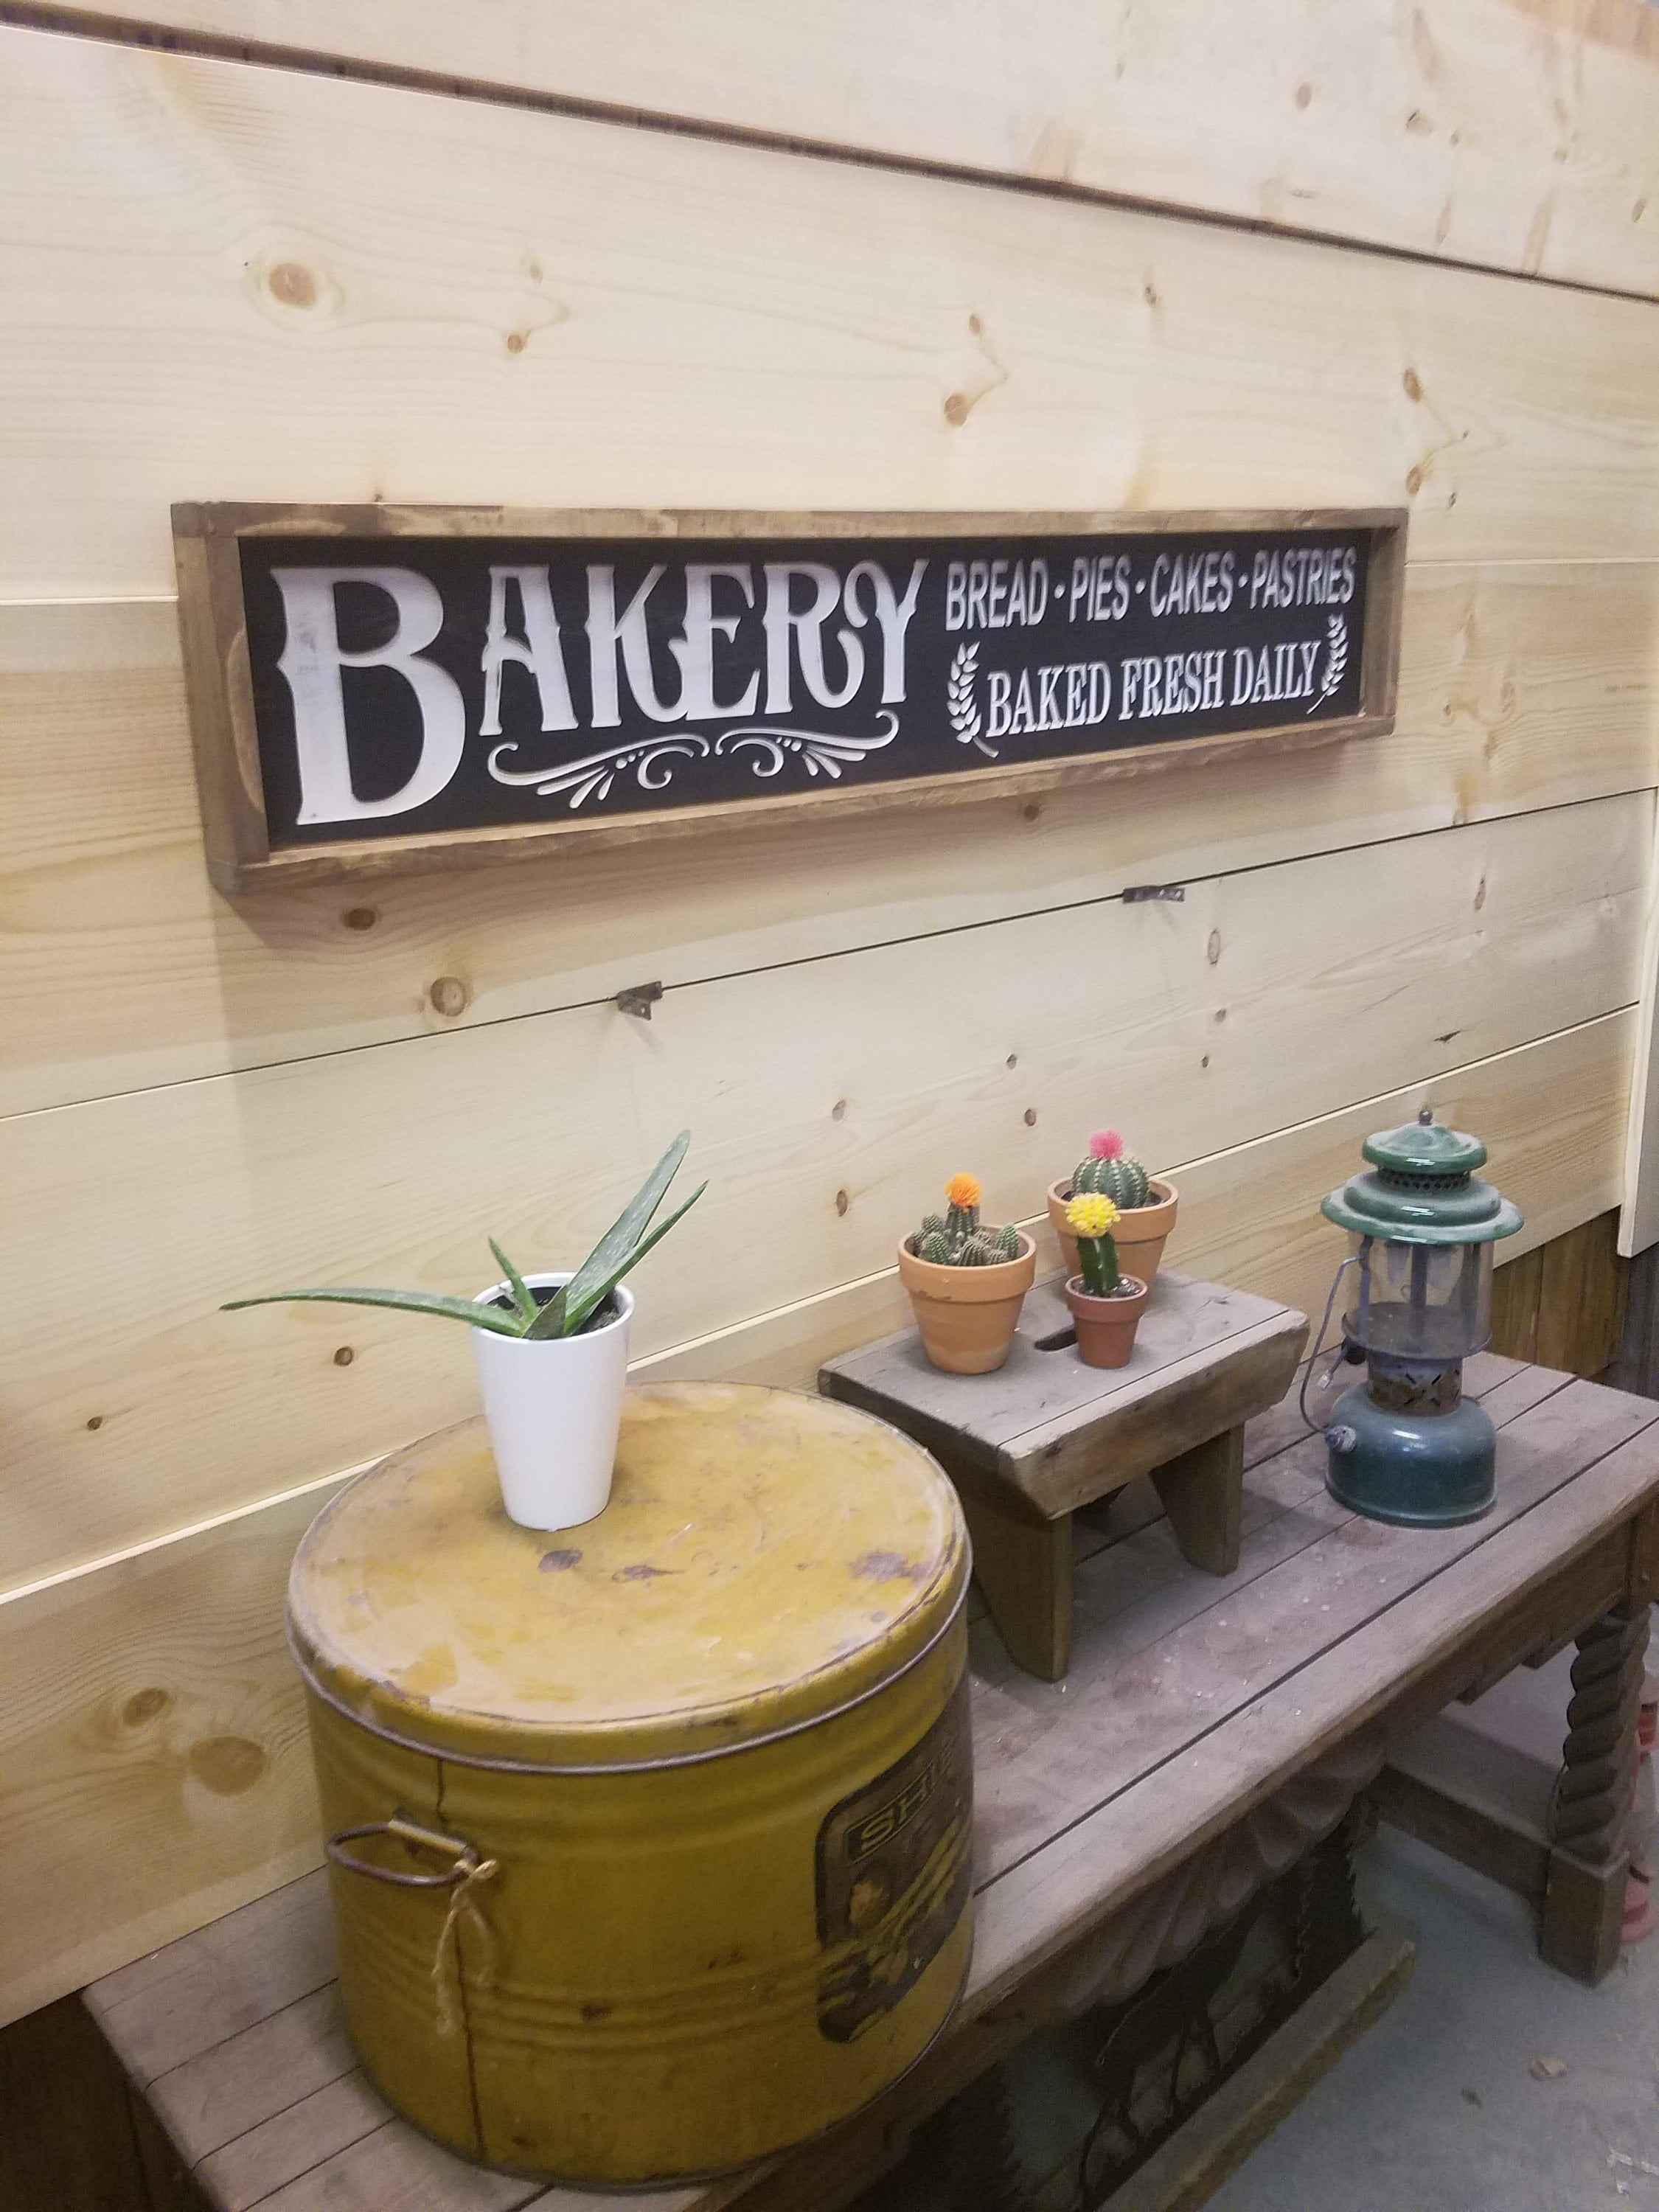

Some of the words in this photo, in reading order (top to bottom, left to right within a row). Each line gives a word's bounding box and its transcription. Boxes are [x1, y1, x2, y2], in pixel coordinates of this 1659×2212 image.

[945, 559, 1048, 630] BREAD
[1068, 554, 1130, 623] PIES
[1149, 552, 1234, 617] CAKES
[1249, 548, 1355, 609] PASTRIES
[270, 557, 928, 826] BAKERY
[985, 661, 1111, 737] BAKED
[1118, 648, 1225, 720] FRESH
[1229, 640, 1322, 706] DAILY
